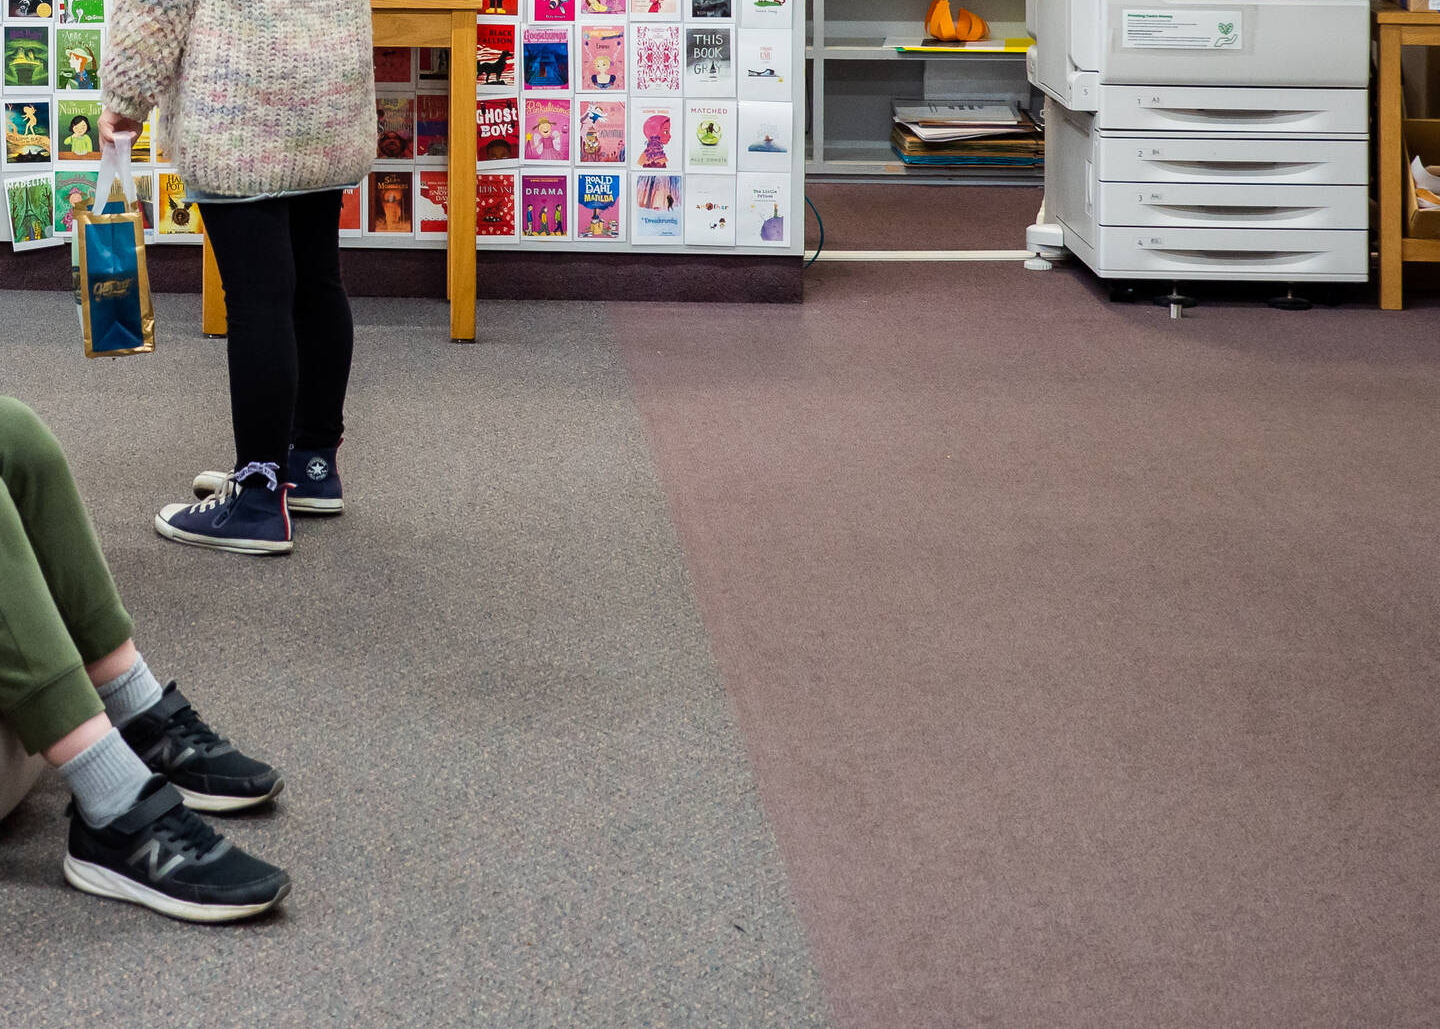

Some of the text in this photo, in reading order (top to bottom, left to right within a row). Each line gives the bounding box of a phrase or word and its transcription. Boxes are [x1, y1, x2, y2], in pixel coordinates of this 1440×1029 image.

[489, 29, 513, 37] BLACK
[693, 34, 724, 46] THIS
[693, 46, 723, 58] BOOK
[59, 105, 85, 116] Name
[476, 104, 518, 124] GHOST
[480, 123, 514, 137] BOYS
[585, 175, 613, 185] ROALD
[525, 187, 564, 196] DRAMA
[585, 184, 613, 194] DAHL
[584, 194, 614, 203] MATILDA
